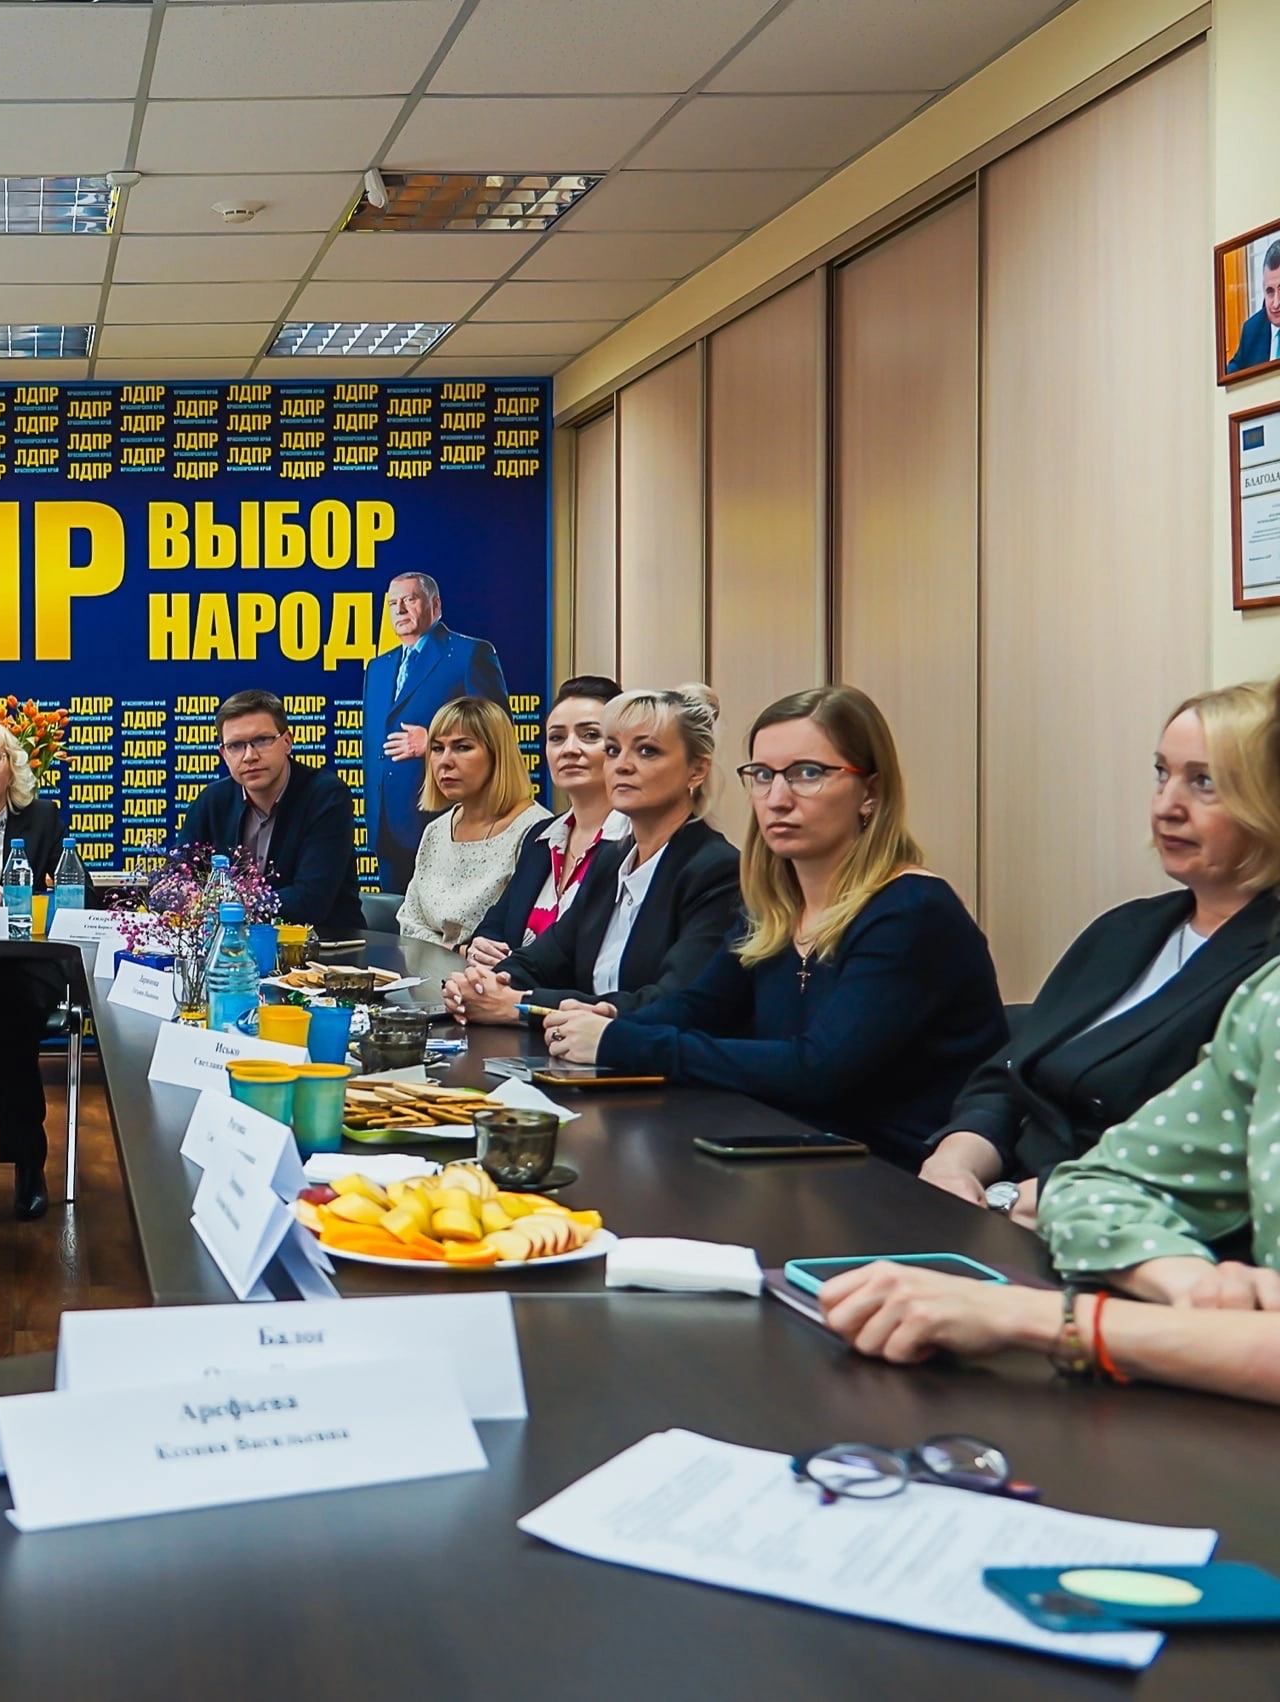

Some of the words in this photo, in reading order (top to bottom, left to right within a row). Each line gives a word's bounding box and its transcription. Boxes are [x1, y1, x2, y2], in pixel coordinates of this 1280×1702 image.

[13, 386, 59, 405] ЛДПР
[120, 385, 165, 404] ЛДПР
[226, 384, 272, 403] ЛДПР
[333, 384, 379, 402] ЛДПР
[440, 383, 486, 401] ЛДПР
[66, 401, 112, 418] ЛДПР
[173, 400, 219, 418] ЛДПР
[279, 399, 325, 417] ЛДПР
[386, 398, 432, 417] ЛДПР
[493, 397, 540, 416] ЛДПР
[13, 415, 59, 434] ЛДПР
[119, 415, 166, 434] ЛДПР
[226, 414, 272, 433] ЛДПР
[334, 413, 379, 433] ЛДПР
[440, 412, 486, 432] ЛДПР
[66, 433, 112, 451] ЛДПР
[173, 432, 219, 451] ЛДПР
[279, 431, 325, 450] ЛДПР
[386, 431, 432, 449] ЛДПР
[493, 430, 540, 449] ЛДПР
[13, 448, 59, 467] ЛДПР
[121, 447, 166, 466] ЛДПР
[227, 446, 272, 465] ЛДПР
[333, 446, 379, 464] ЛДПР
[439, 445, 486, 464] ЛДПР
[68, 462, 113, 481] ЛДПР
[174, 461, 219, 480] ЛДПР
[280, 461, 326, 479] ЛДПР
[386, 460, 432, 479] ЛДПР
[493, 459, 540, 479] ЛДПР
[148, 500, 395, 569] ВЫБОР
[69, 697, 113, 715] ЛДПР
[175, 696, 220, 715] ЛДПР
[508, 695, 540, 714] ДПР
[121, 710, 167, 729] ЛДПР
[68, 725, 113, 744] ЛДПР
[175, 725, 218, 743] ЛДПР
[288, 725, 326, 743] ДПР
[122, 740, 167, 758] ЛДПР
[69, 755, 113, 773] ЛДПР
[175, 754, 220, 773] ЛДПР
[122, 769, 167, 788] ЛДПР
[69, 784, 114, 802] ЛДПР
[122, 799, 167, 817] ЛДПР
[69, 813, 114, 832] ЛДПР
